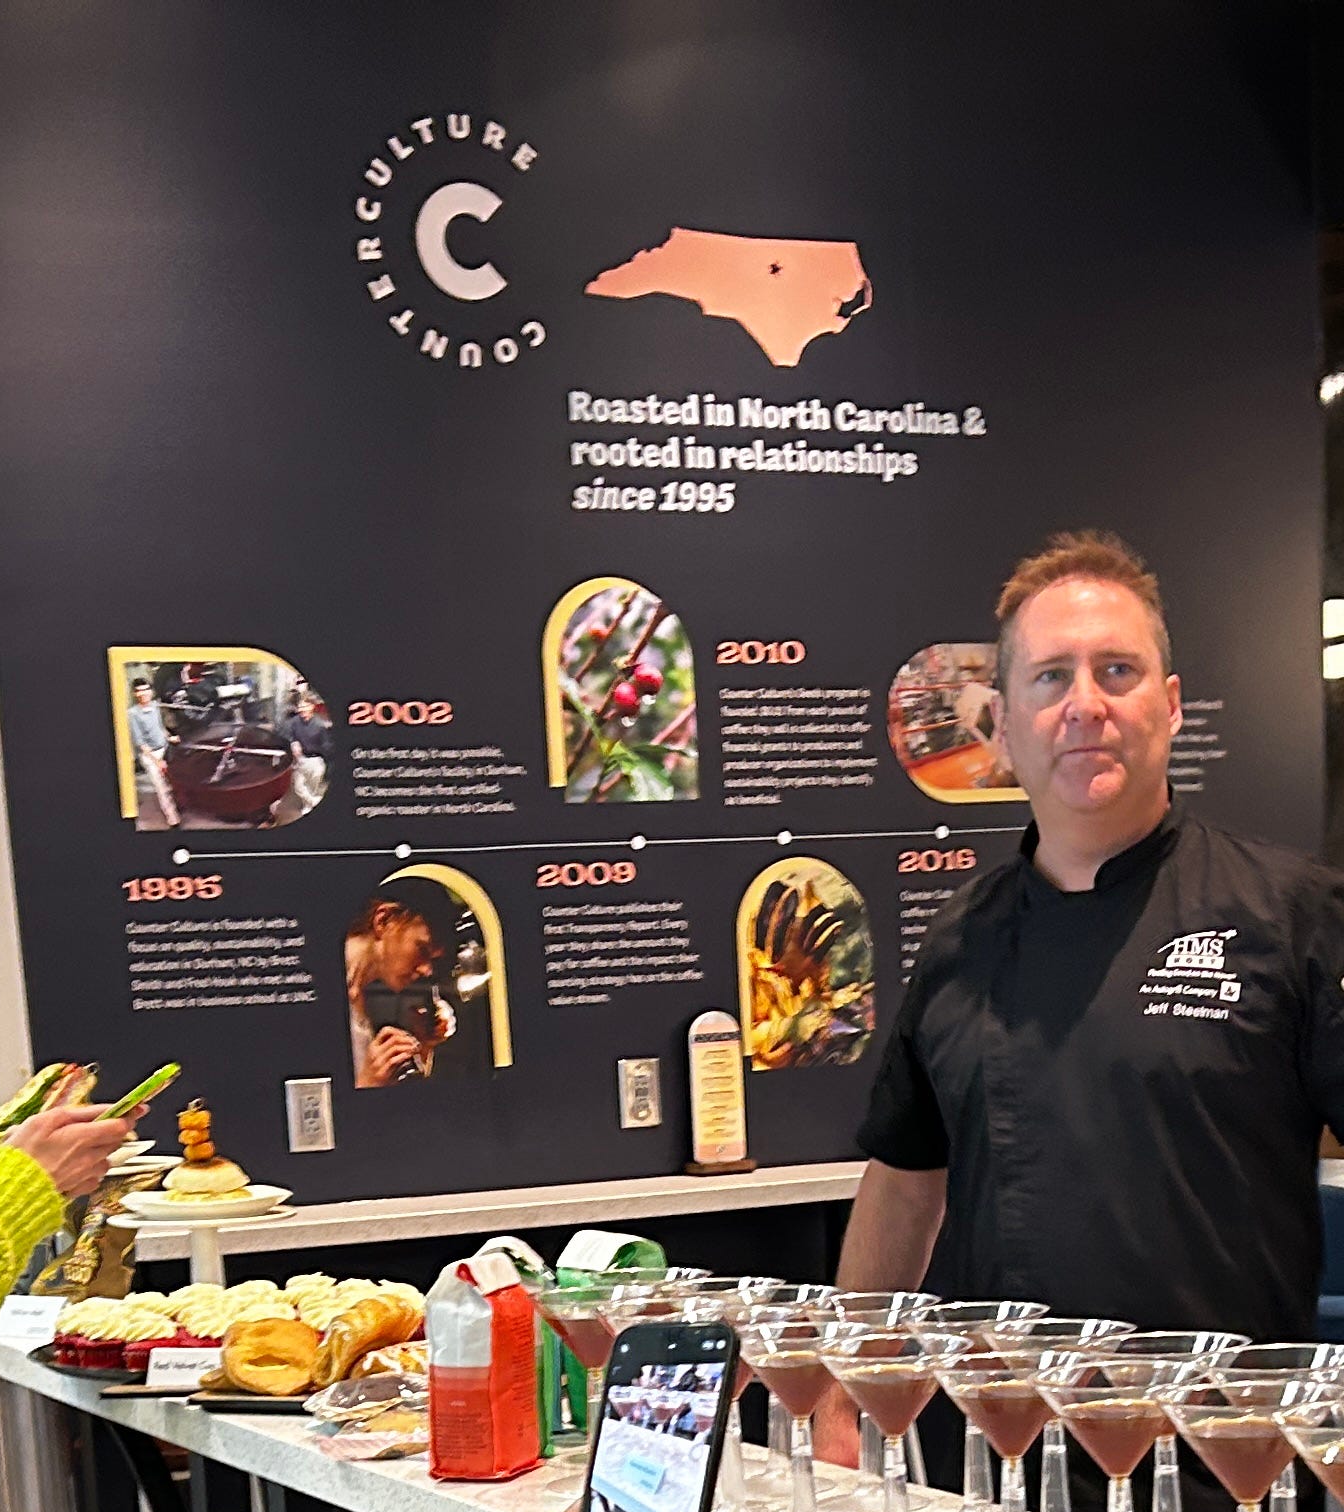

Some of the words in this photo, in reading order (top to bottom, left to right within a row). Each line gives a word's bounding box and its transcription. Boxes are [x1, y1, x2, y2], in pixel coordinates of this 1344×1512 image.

[567, 390, 699, 425] Roasted
[703, 394, 735, 427] in
[738, 397, 831, 431] North
[834, 400, 960, 435] Carolina
[962, 406, 987, 436] &
[570, 436, 680, 468] rooted
[684, 437, 716, 470] in
[719, 440, 920, 483] relationships
[571, 477, 656, 511] since
[658, 481, 736, 513] 1995
[716, 640, 806, 665] 2010
[348, 701, 454, 726] 2002
[898, 848, 977, 873] 2016
[536, 862, 638, 887] 2009
[121, 874, 224, 902] 1995
[1173, 937, 1225, 957] HMS
[1143, 1001, 1170, 1015] Jeff
